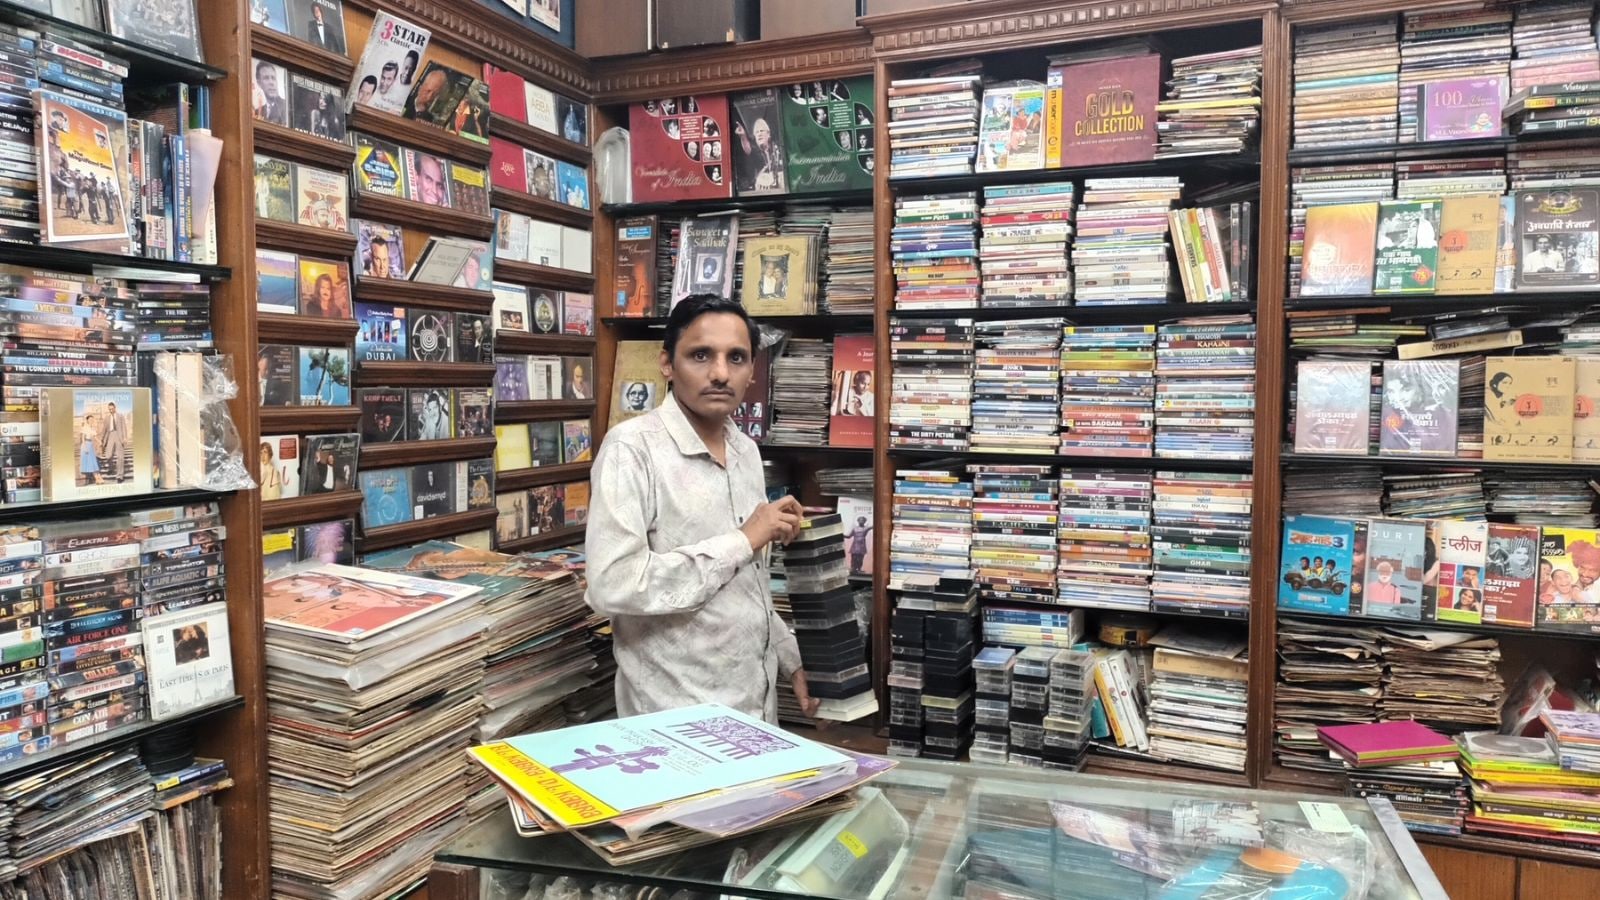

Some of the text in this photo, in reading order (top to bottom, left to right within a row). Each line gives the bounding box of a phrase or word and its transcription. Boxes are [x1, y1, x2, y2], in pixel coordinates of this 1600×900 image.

[381, 20, 427, 47] 3 STAR
[390, 36, 412, 49] Classic
[1085, 89, 1135, 119] GOLD
[1432, 90, 1463, 107] 100
[1075, 114, 1144, 137] COLLECTION
[1556, 120, 1568, 133] 101
[58, 353, 88, 361] EVEREST
[366, 351, 397, 362] DUBAI
[15, 365, 116, 376] THE CONQUEST OF EVEREST
[67, 536, 110, 549] ELEKTRA
[1332, 536, 1345, 549] 3
[1448, 535, 1483, 553] प्लीज
[165, 560, 206, 571] TERMINATOR
[66, 624, 130, 645] AIR FORCE ONE
[72, 707, 109, 725] CON AIR
